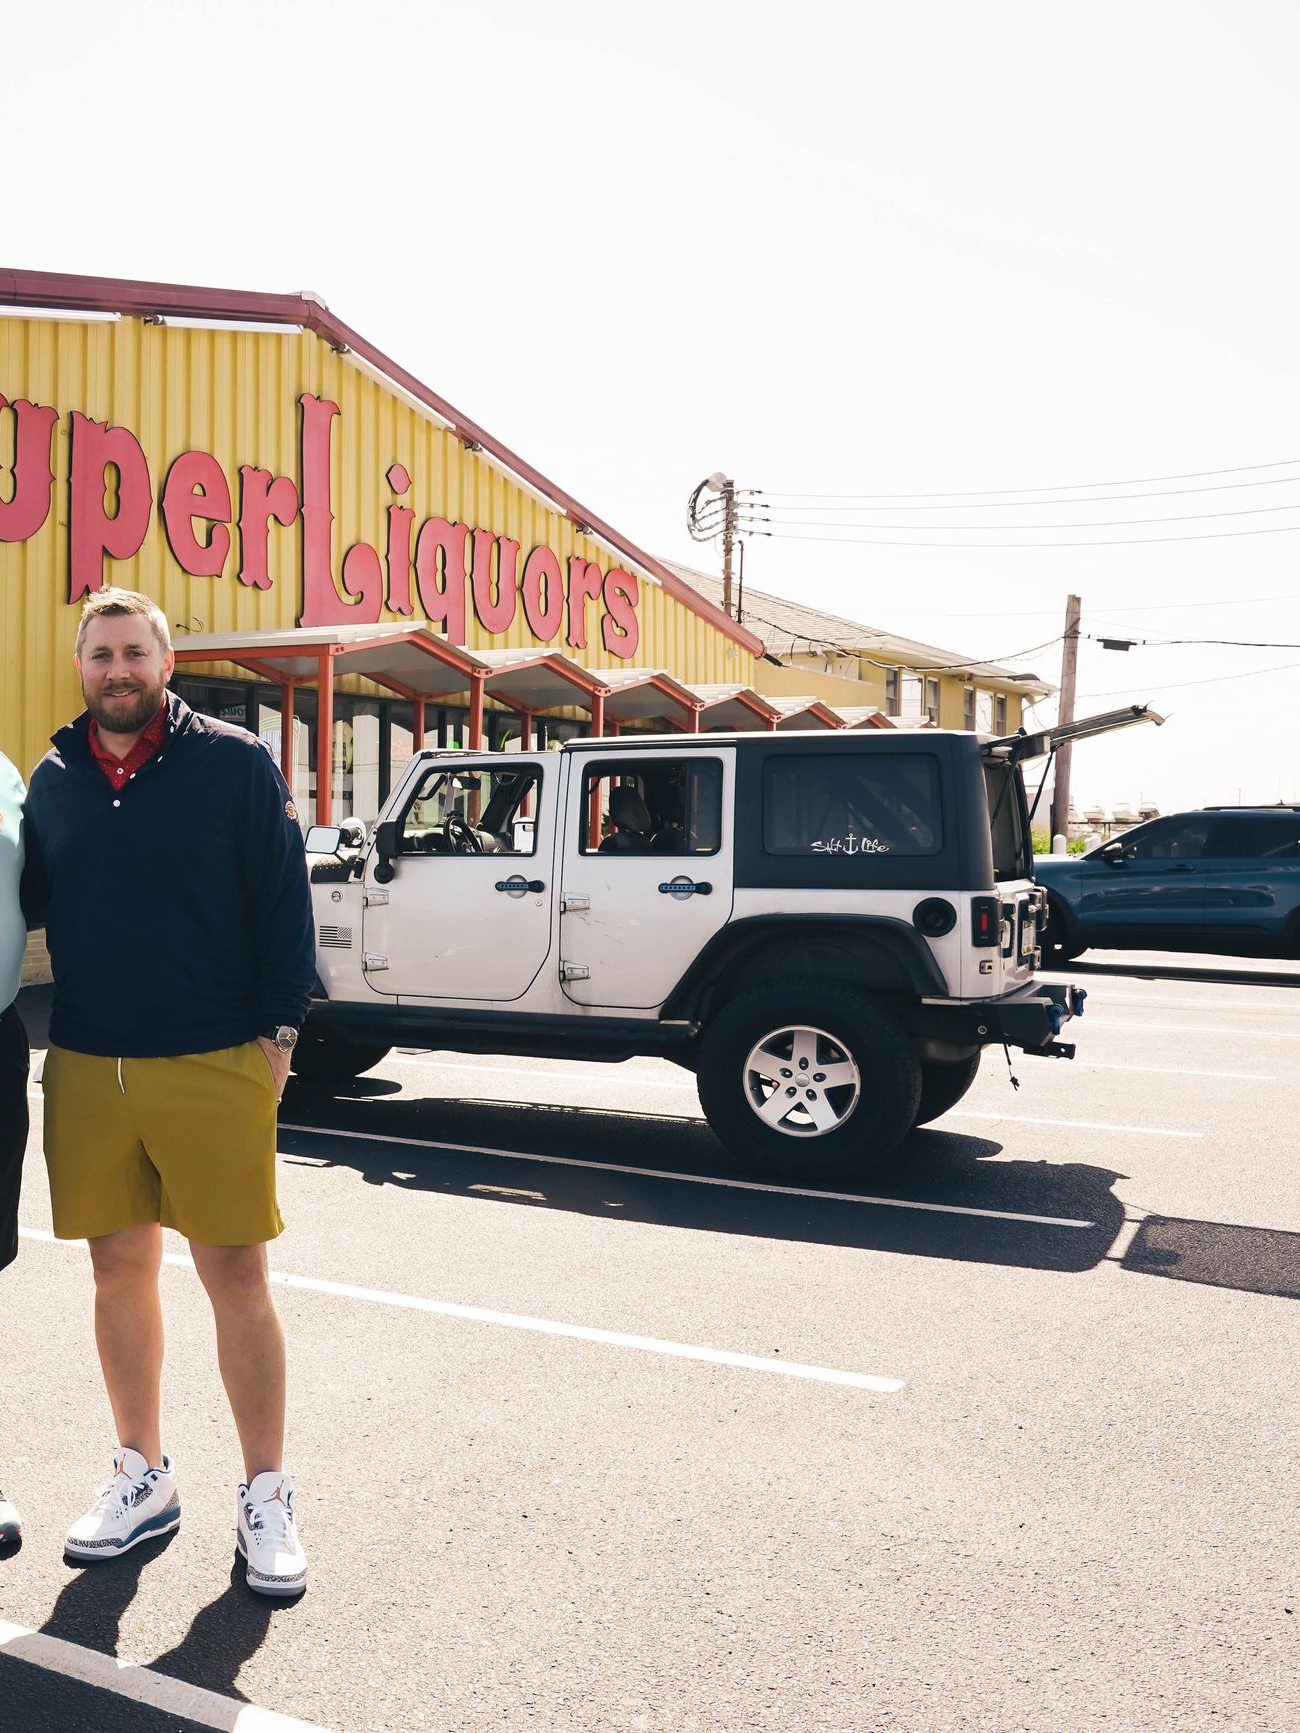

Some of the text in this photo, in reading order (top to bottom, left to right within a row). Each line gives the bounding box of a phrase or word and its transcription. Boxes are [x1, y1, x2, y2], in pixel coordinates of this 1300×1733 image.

[298, 393, 640, 659] Liquors
[810, 837, 890, 854] Salt Life
